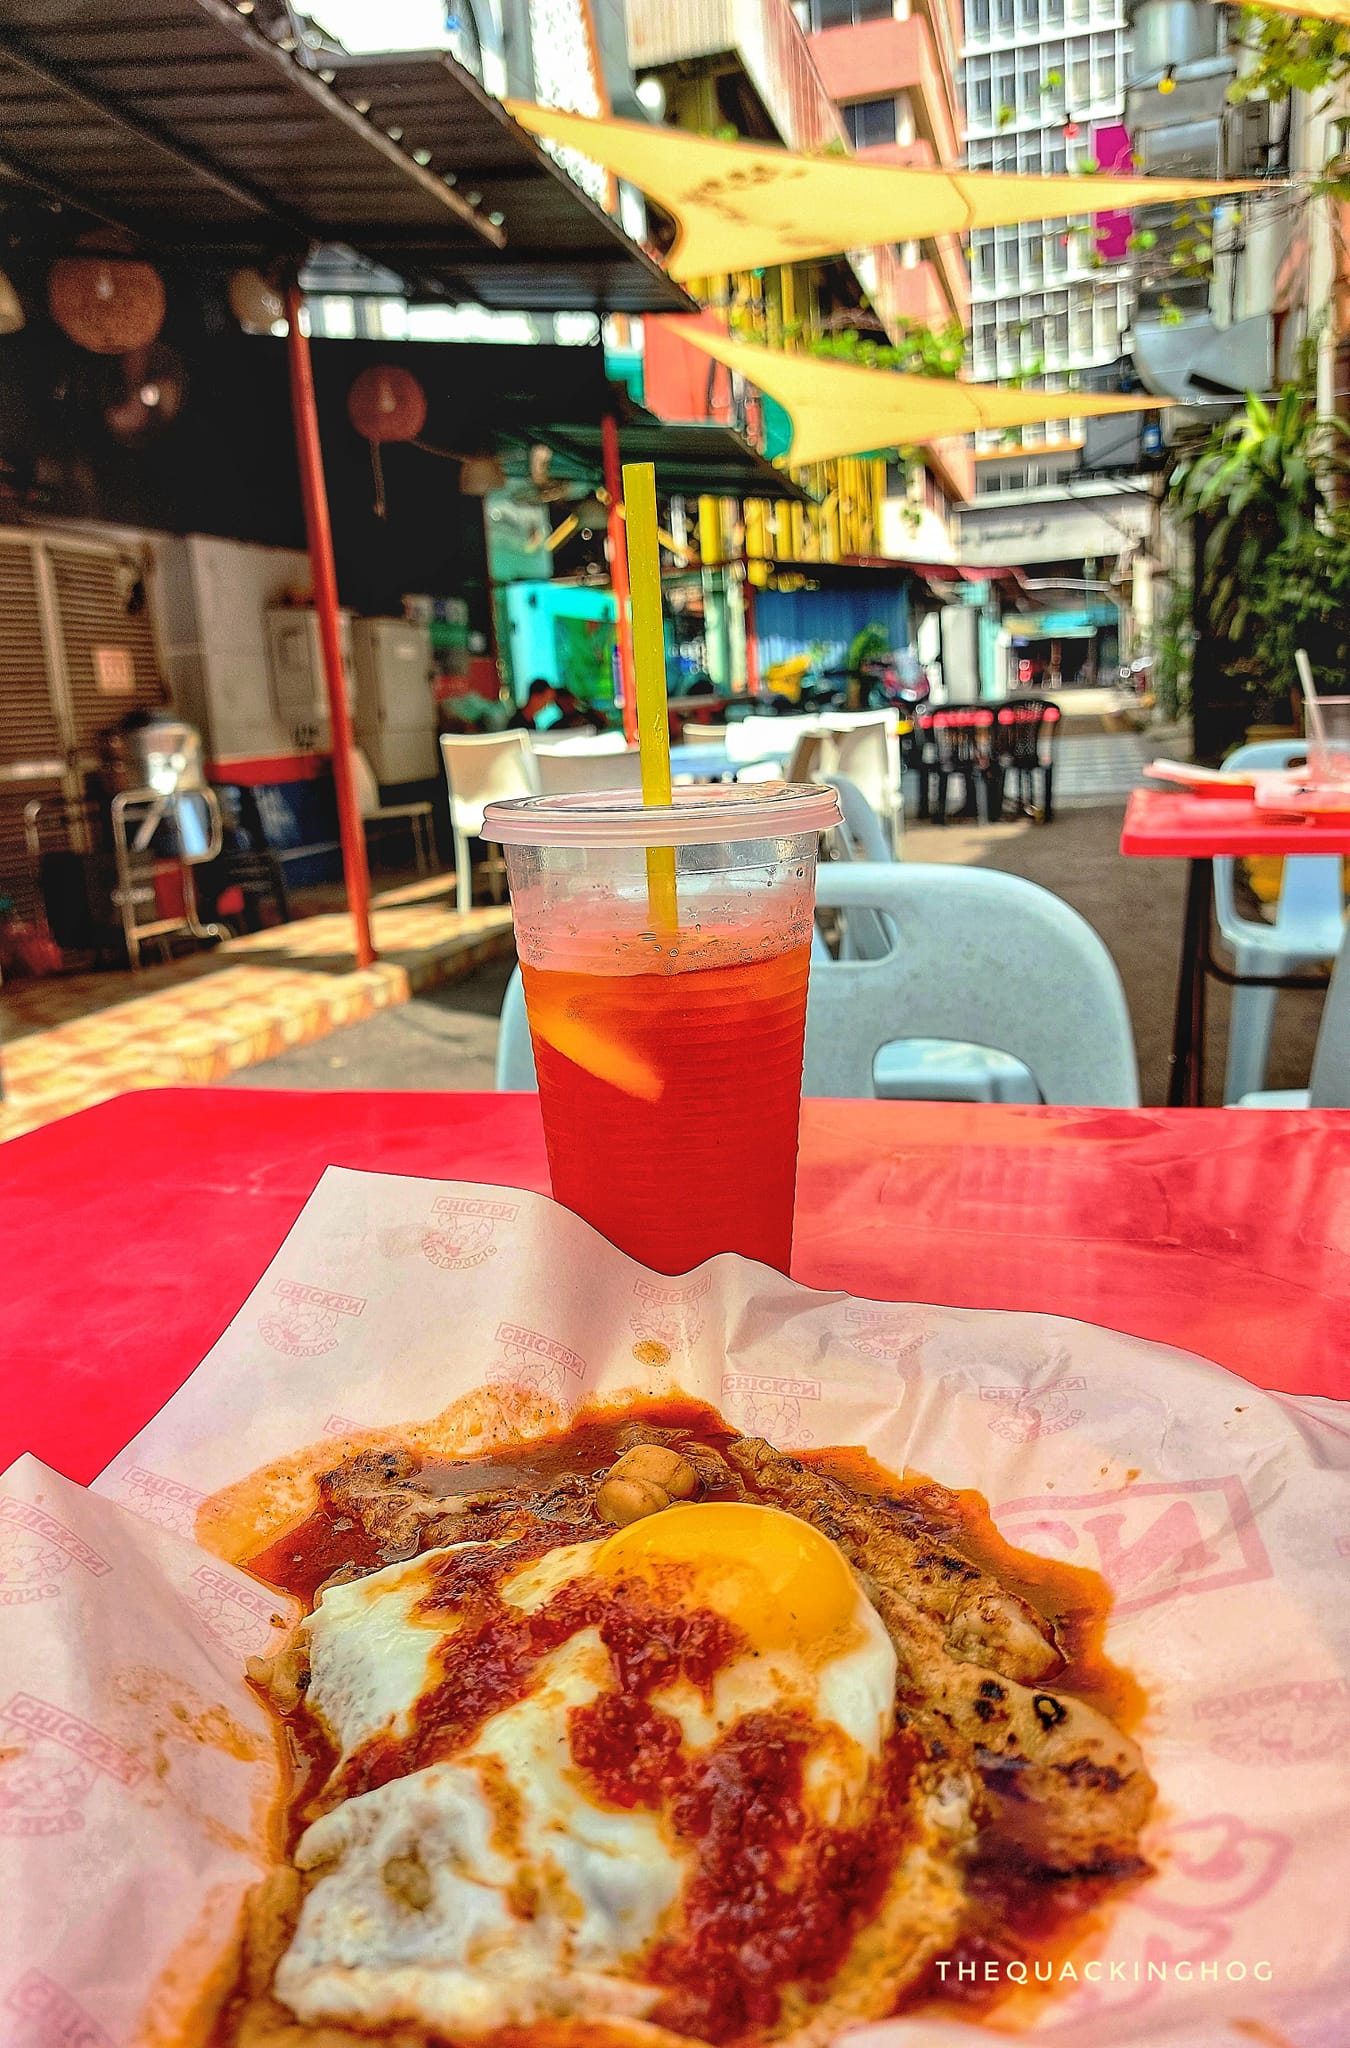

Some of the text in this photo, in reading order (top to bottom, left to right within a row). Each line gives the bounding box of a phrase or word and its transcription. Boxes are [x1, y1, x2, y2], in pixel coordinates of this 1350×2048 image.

[436, 1199, 515, 1219] CHICKEN
[278, 1283, 362, 1313] CHICKEN
[500, 1327, 583, 1374] CHICKEN
[723, 1376, 818, 1397] CHICKEN
[200, 1569, 273, 1615] CHICK
